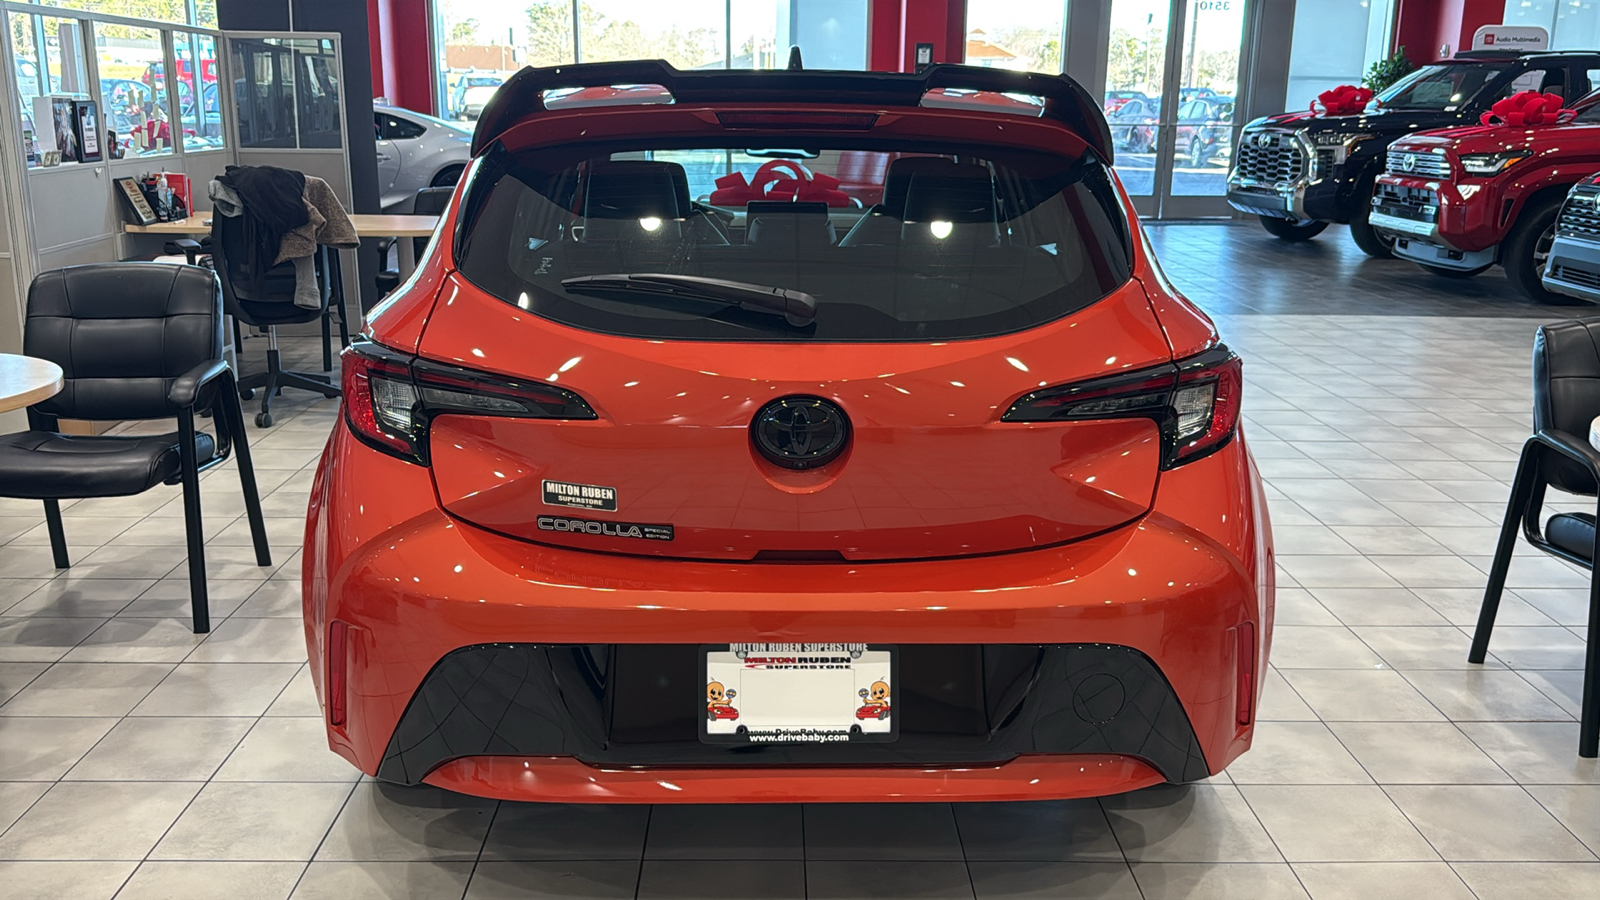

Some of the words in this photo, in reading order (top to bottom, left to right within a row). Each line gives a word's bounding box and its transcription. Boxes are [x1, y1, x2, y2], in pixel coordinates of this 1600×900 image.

[546, 482, 580, 496] MILTON
[581, 487, 613, 500] RUBEN
[558, 495, 603, 506] SUPERSTORE
[537, 517, 643, 538] COROLLA
[729, 643, 766, 652] MILTON
[768, 643, 802, 652] RUBEN
[804, 643, 868, 652] SUPERSTORE
[749, 733, 849, 743] www.drivebaby.com
